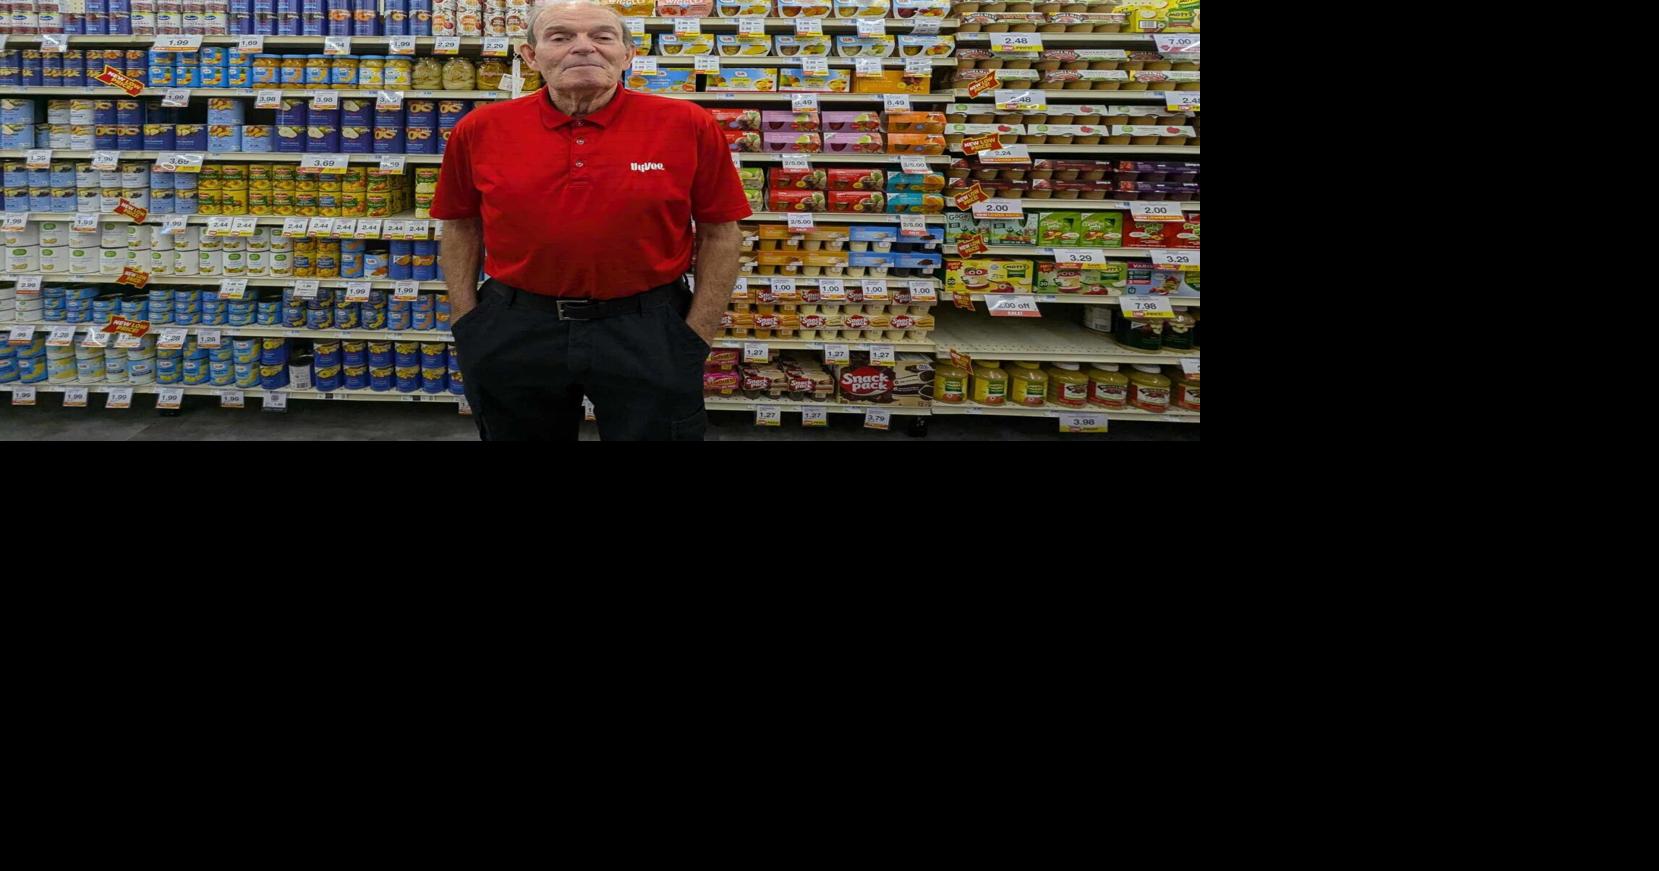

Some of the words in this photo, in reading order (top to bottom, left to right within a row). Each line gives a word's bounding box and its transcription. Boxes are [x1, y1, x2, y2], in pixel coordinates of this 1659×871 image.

[964, 140, 979, 148] NEW
[979, 137, 996, 145] LOW
[986, 204, 1009, 212] 2.00
[1135, 302, 1157, 310] 7.98
[130, 321, 148, 329] LOW
[841, 373, 889, 385] Snack
